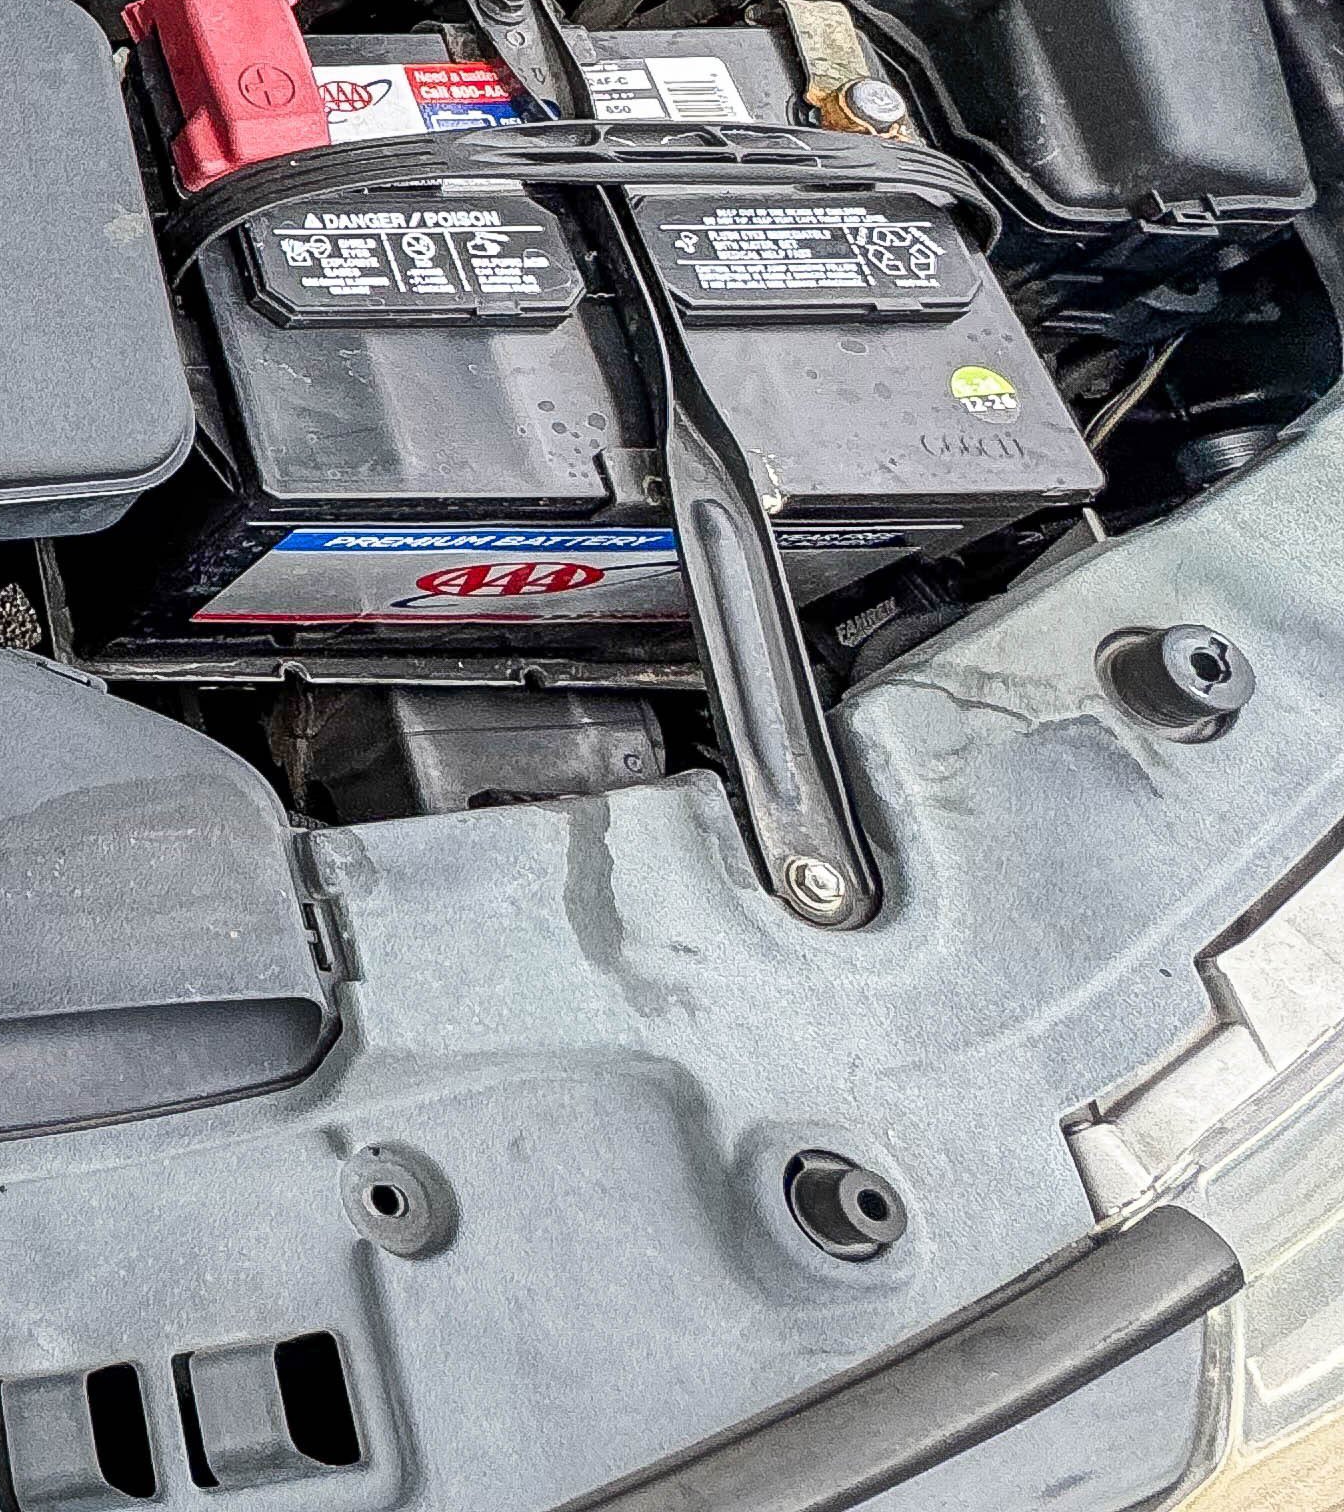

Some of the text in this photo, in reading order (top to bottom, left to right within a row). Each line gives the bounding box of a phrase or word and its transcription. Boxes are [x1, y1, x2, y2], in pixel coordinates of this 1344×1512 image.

[322, 210, 501, 229] DANGER / POISON
[324, 534, 492, 548] PREMIUM
[492, 534, 662, 547] BATTERY
[416, 562, 604, 596] AAA
